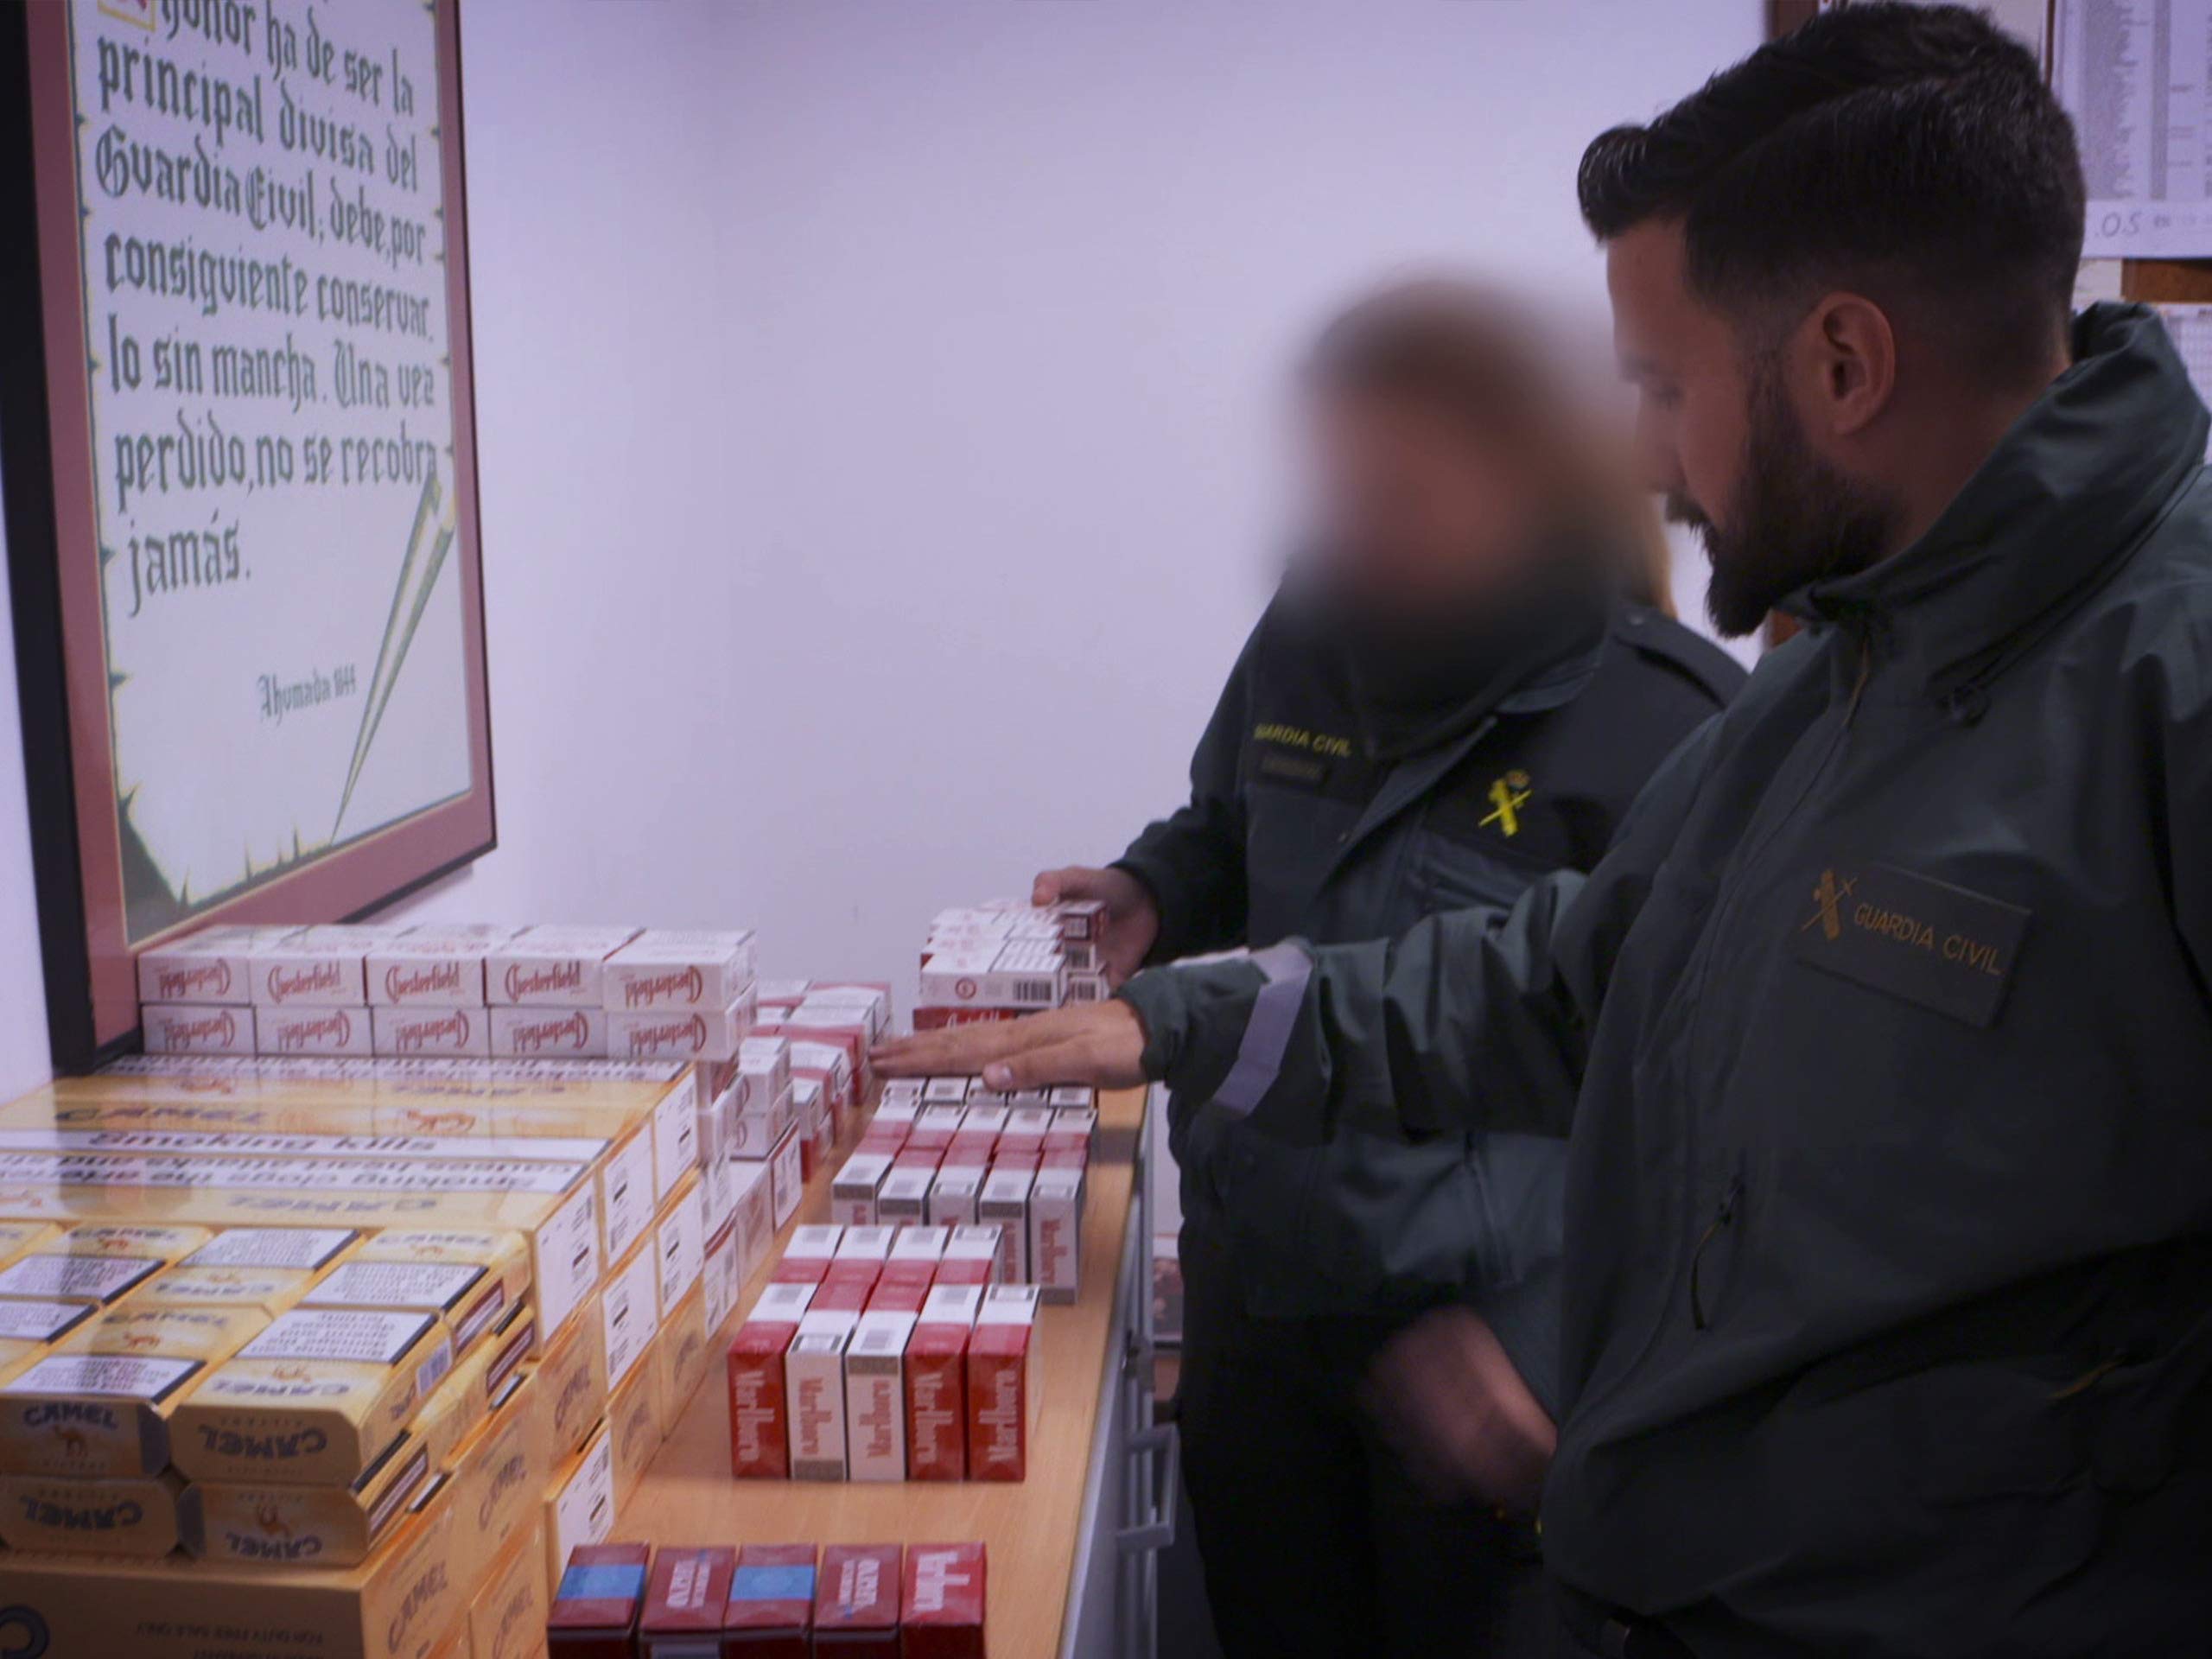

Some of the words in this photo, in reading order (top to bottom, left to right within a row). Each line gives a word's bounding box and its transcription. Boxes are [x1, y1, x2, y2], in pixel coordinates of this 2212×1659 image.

[265, 0, 297, 81] ha
[306, 7, 336, 85] de
[345, 48, 383, 107] ser
[391, 48, 415, 117] la
[98, 35, 264, 147] principal
[279, 83, 374, 175] divisa
[385, 124, 417, 193] del
[96, 124, 240, 215] Guardia
[105, 231, 308, 316] consiguiente
[108, 314, 142, 394] lo
[154, 327, 203, 394] sin
[334, 339, 390, 410] Una
[258, 433, 293, 487] no
[304, 431, 333, 484] se
[341, 420, 438, 486] recobra
[128, 508, 251, 619] jamás.
[1312, 734, 1352, 759] CIVIL
[1854, 903, 1936, 950] GUARDIA
[1942, 934, 2003, 976] CIVIL
[22, 1402, 118, 1430] CAMEL
[198, 1424, 327, 1459] CAMEL
[19, 1495, 143, 1531] CAMEL
[226, 1532, 323, 1560] CAMEL
